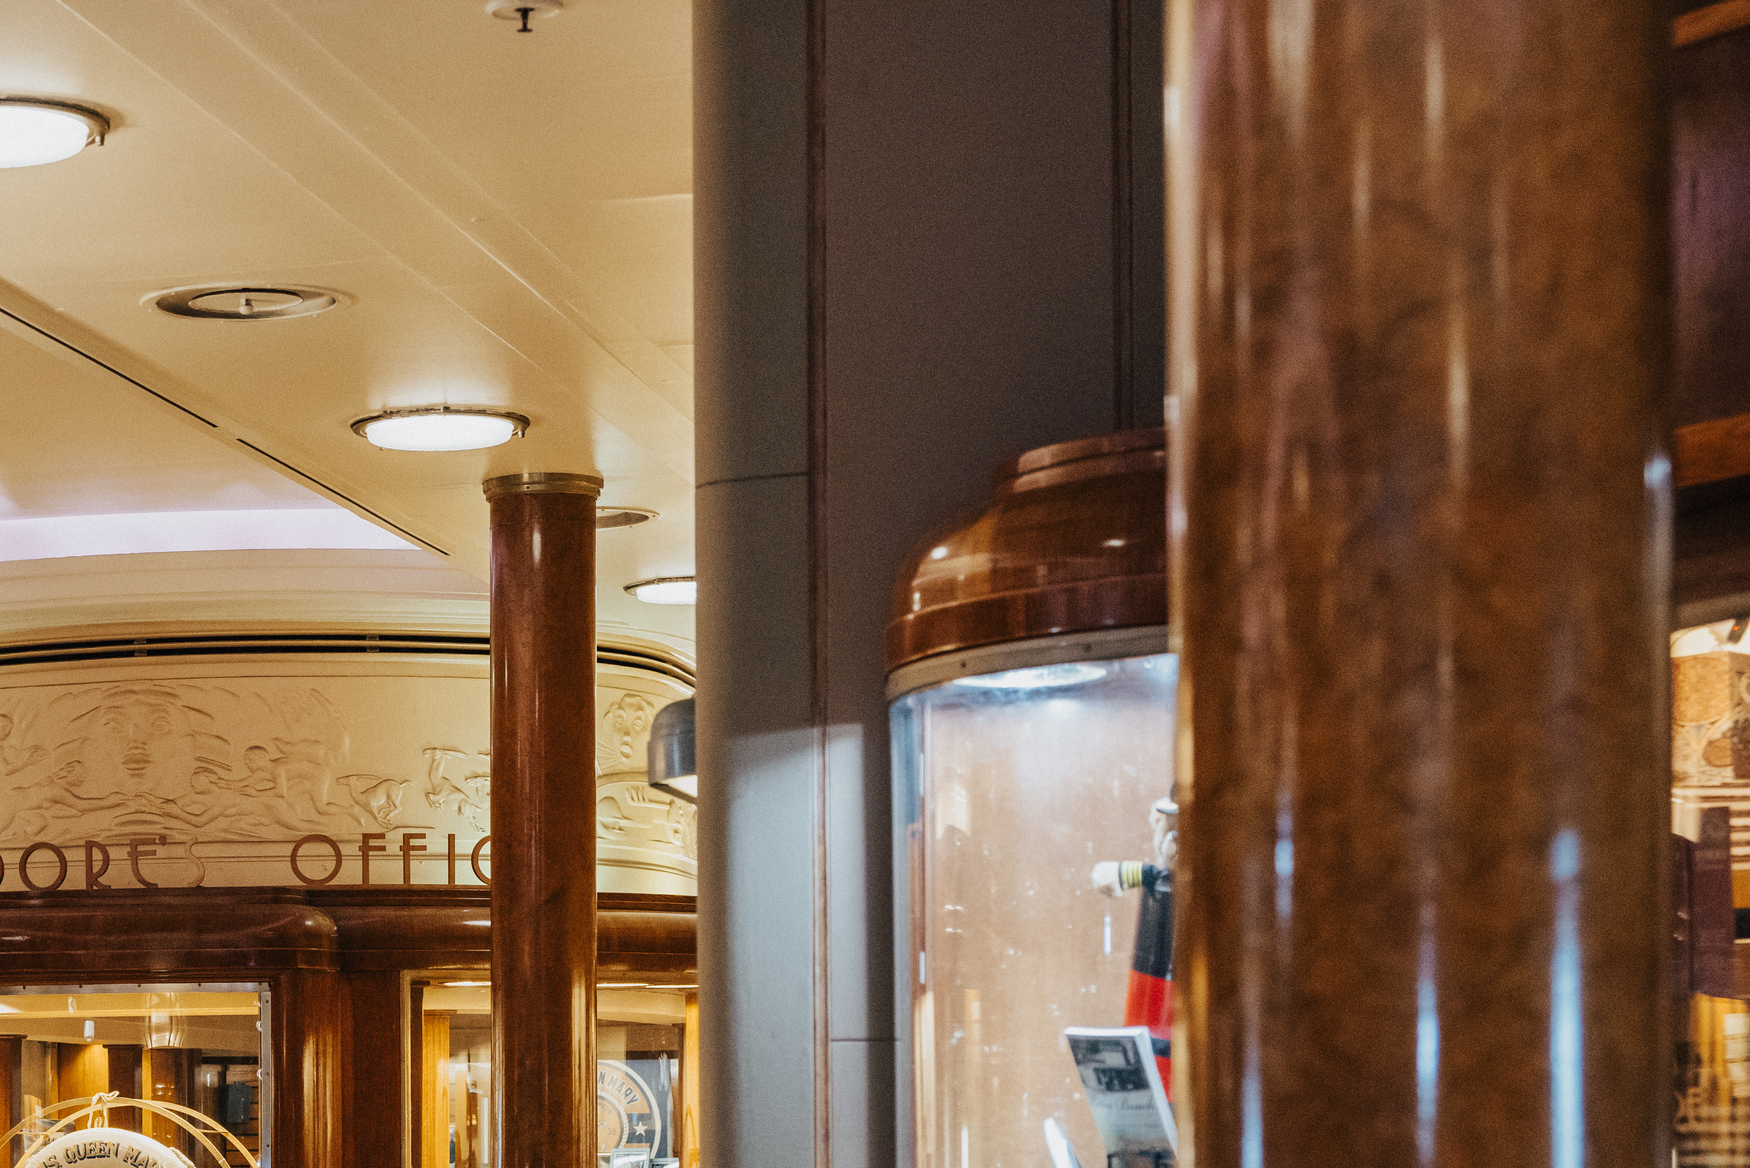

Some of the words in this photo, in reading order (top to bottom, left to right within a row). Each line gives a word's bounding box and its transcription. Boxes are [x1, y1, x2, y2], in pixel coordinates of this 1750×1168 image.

[289, 832, 492, 886] OFFIC
[607, 1073, 640, 1106] MARY
[63, 1140, 120, 1165] QUEEN
